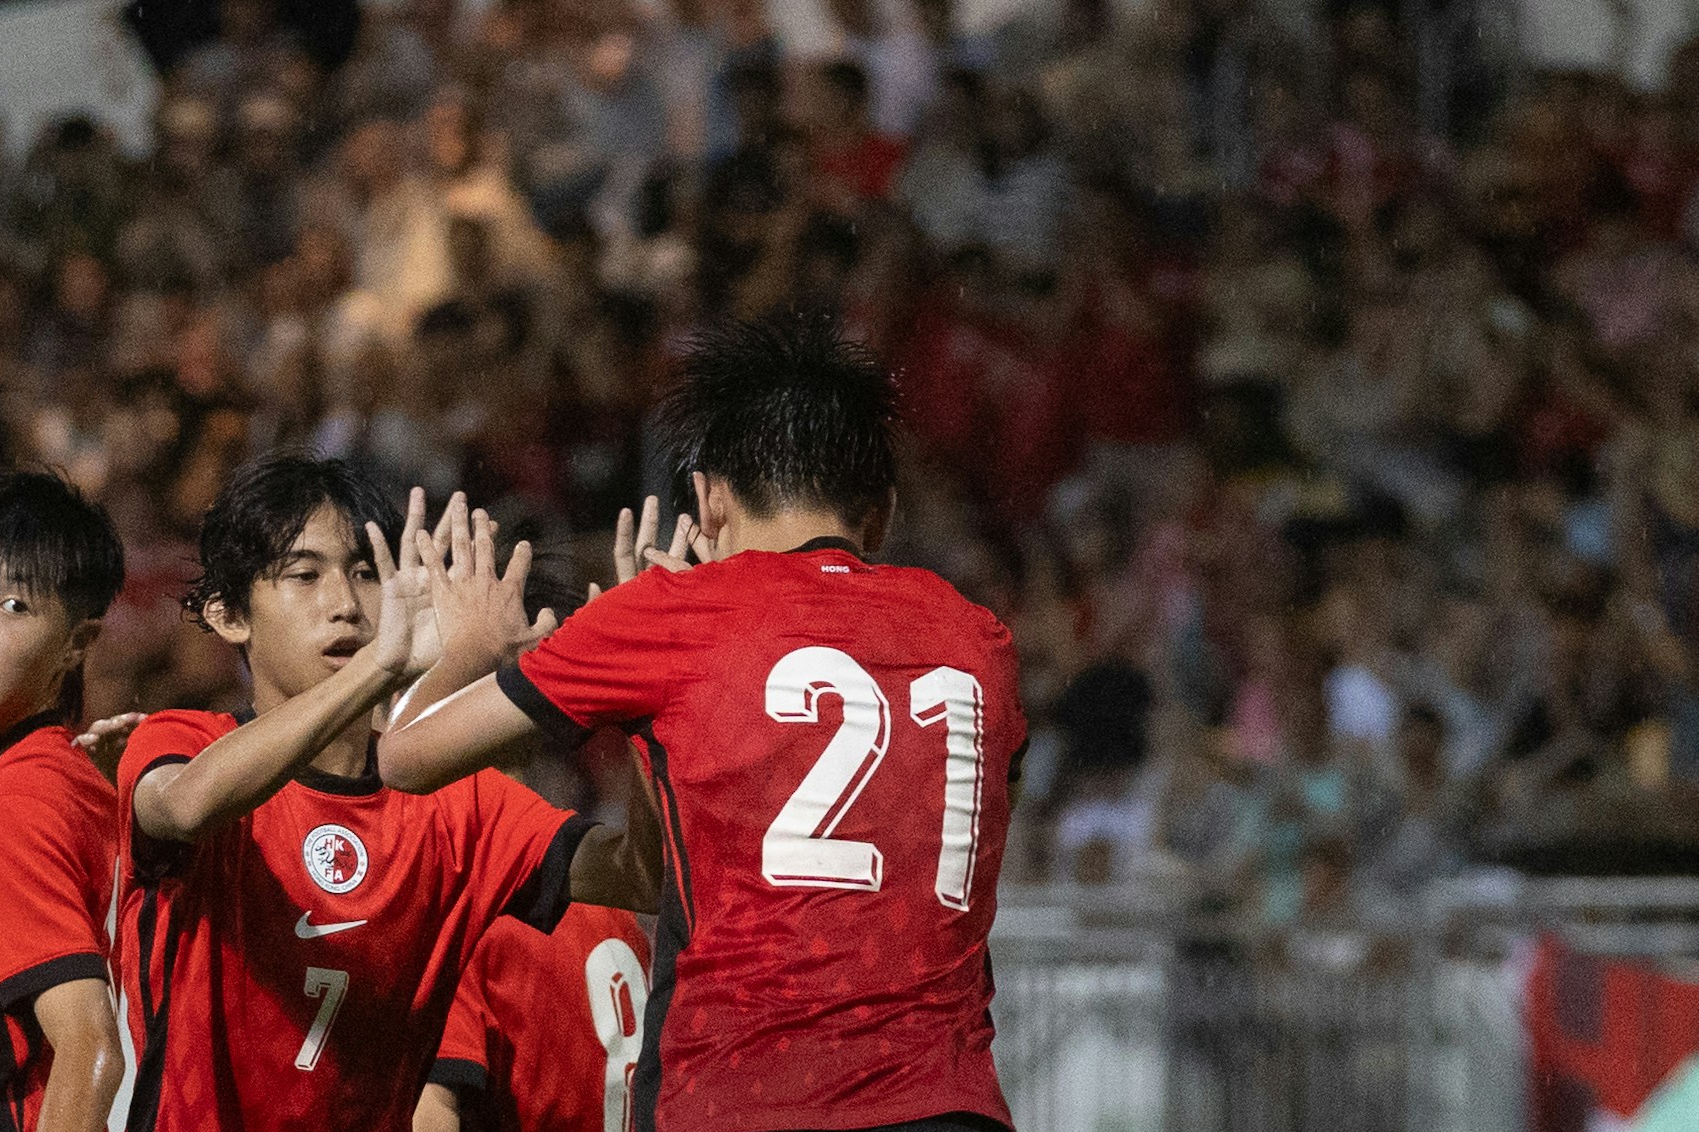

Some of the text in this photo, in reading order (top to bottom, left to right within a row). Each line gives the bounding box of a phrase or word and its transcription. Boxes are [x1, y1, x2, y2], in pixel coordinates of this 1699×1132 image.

[821, 565, 850, 574] HONG
[762, 645, 985, 913] 21
[293, 966, 349, 1072] 7
